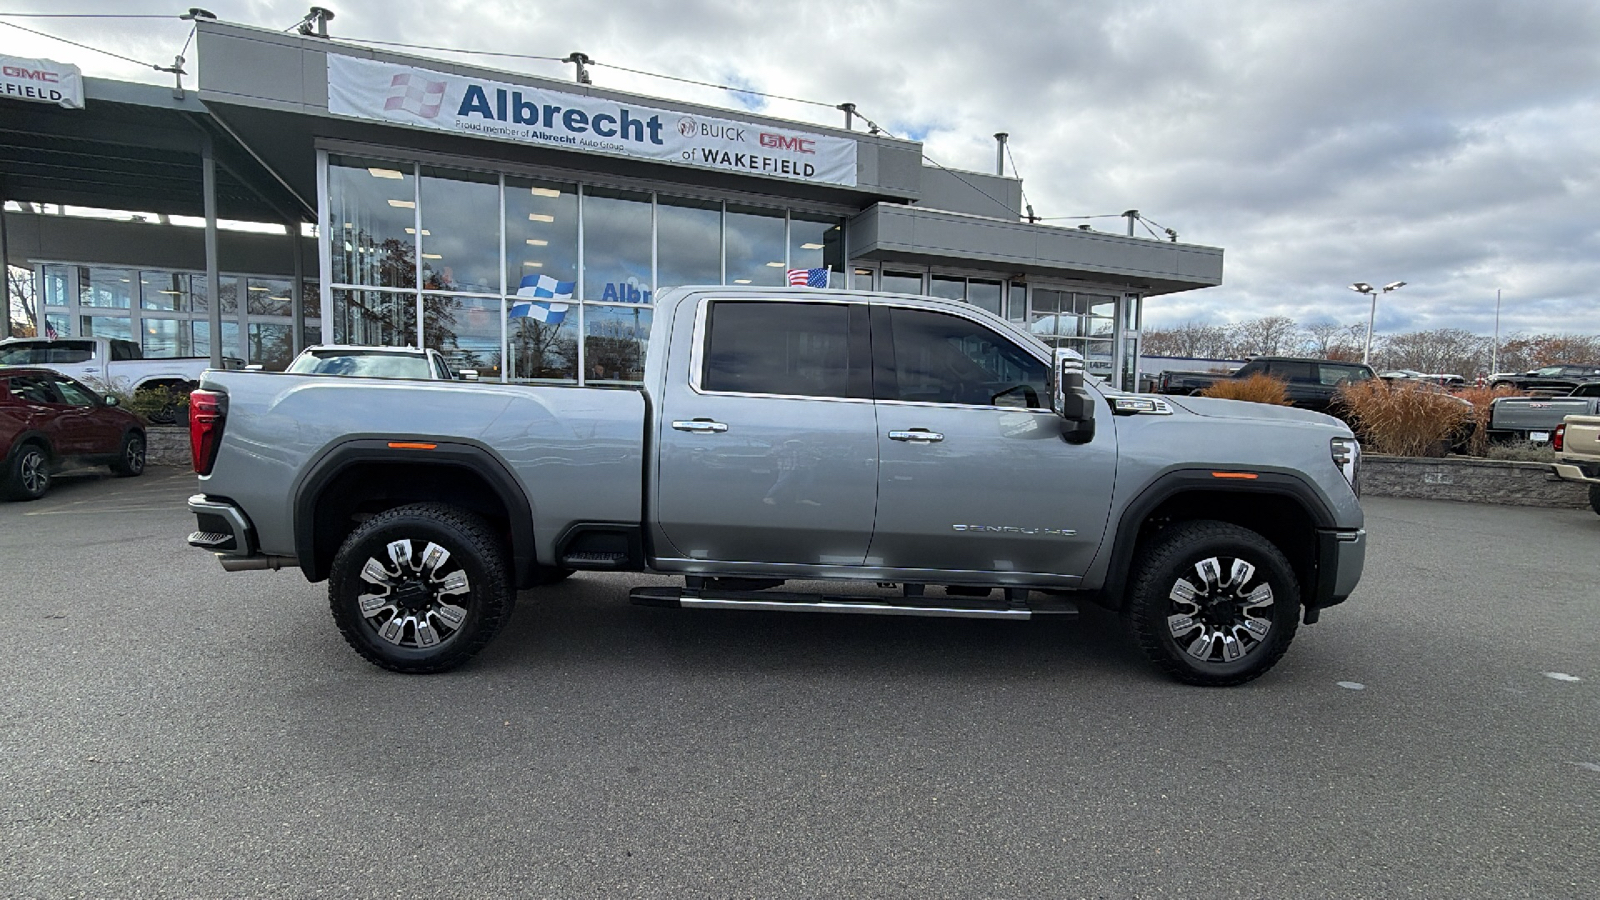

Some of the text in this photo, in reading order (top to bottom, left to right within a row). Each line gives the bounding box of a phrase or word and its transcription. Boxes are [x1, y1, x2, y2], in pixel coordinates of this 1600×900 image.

[3, 66, 59, 83] GMC
[457, 84, 664, 146] Albrecht
[456, 120, 624, 152] Proud member of Albrecht Auto Group
[701, 123, 815, 155] BUICK GMC
[682, 148, 815, 177] of WAKEFIELD
